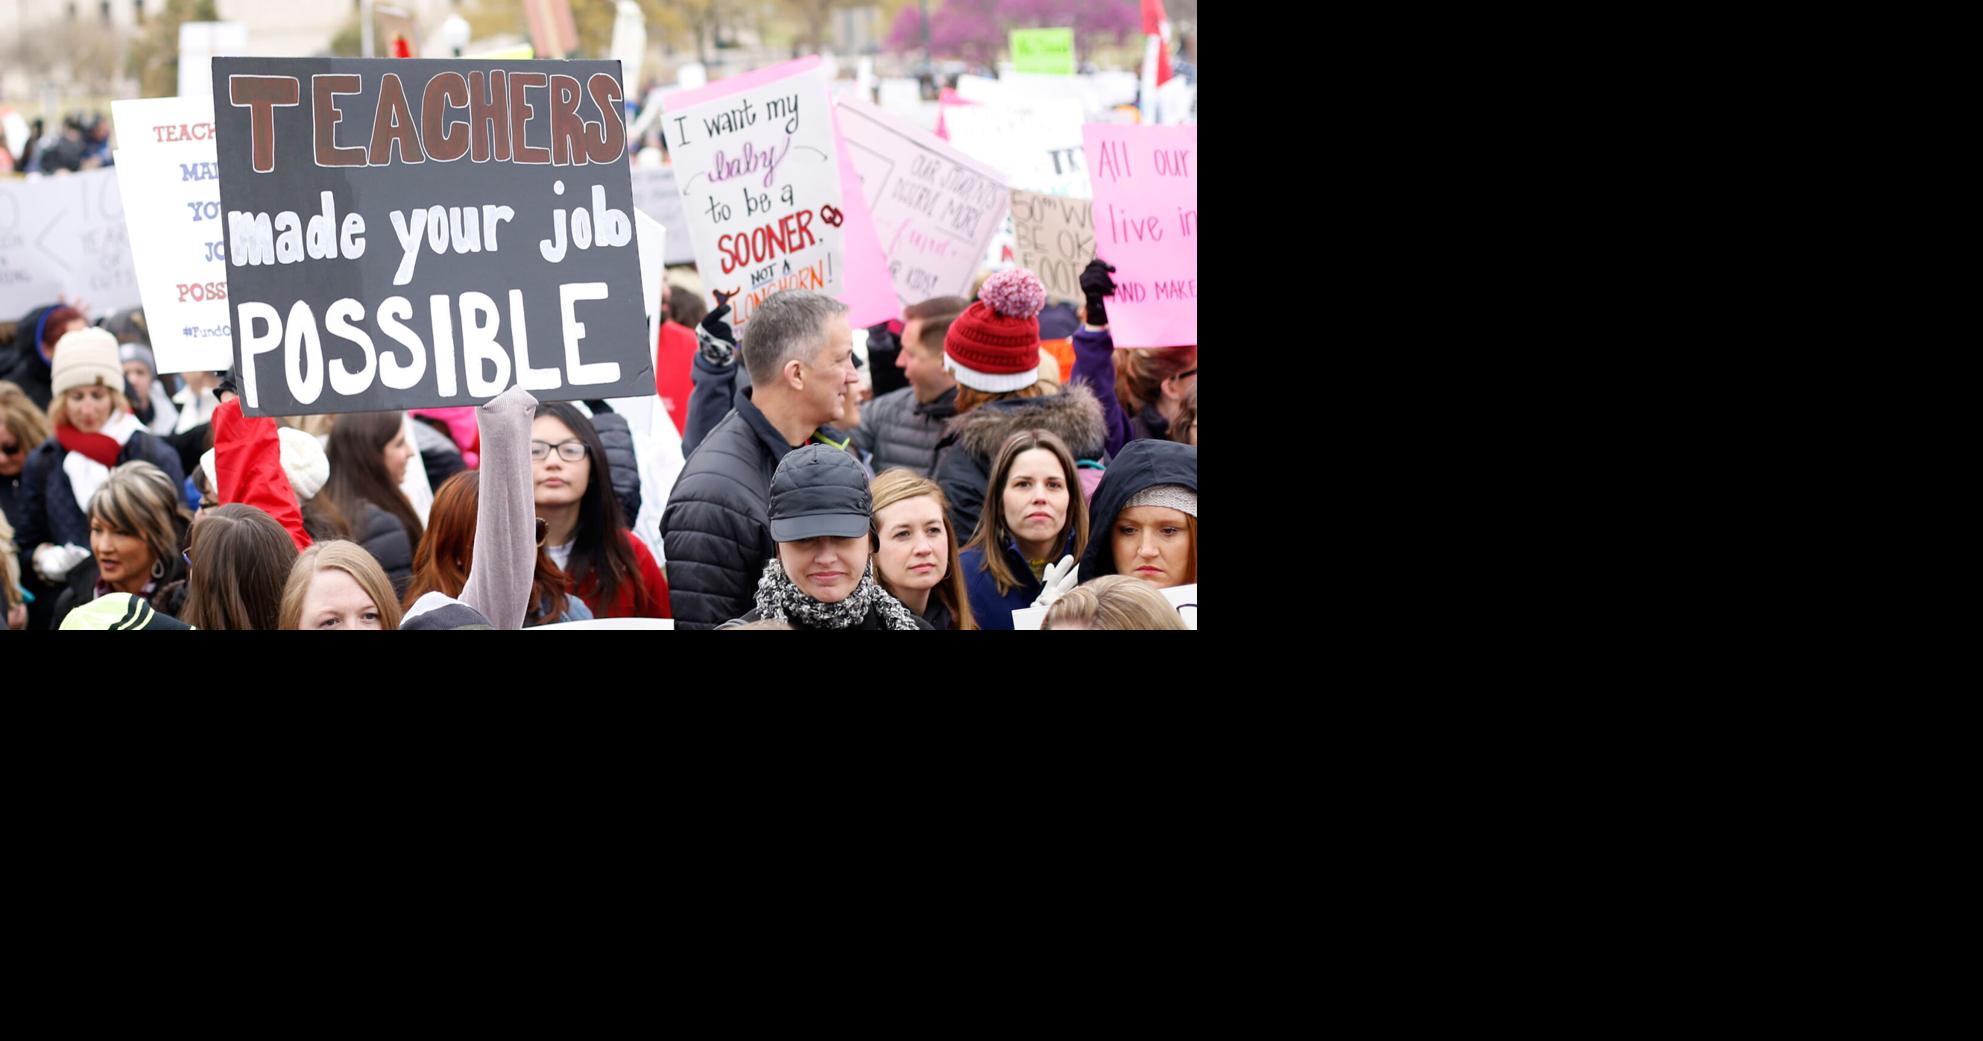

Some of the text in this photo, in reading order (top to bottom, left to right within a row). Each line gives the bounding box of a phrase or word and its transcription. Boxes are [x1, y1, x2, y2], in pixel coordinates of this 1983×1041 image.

[229, 69, 625, 173] TEACHERS
[673, 94, 799, 148] I want my
[708, 138, 787, 188] baby
[1099, 140, 1189, 182] All our
[187, 201, 221, 222] YO
[705, 184, 795, 224] to be a
[1109, 203, 1163, 244] live
[227, 180, 632, 285] made your job
[1016, 222, 1049, 254] BE
[1058, 229, 1097, 262] OK
[176, 281, 227, 302] POSS
[751, 263, 776, 286] NOT
[1112, 279, 1197, 303] AND MAKE
[236, 281, 622, 409] POSSIBLE
